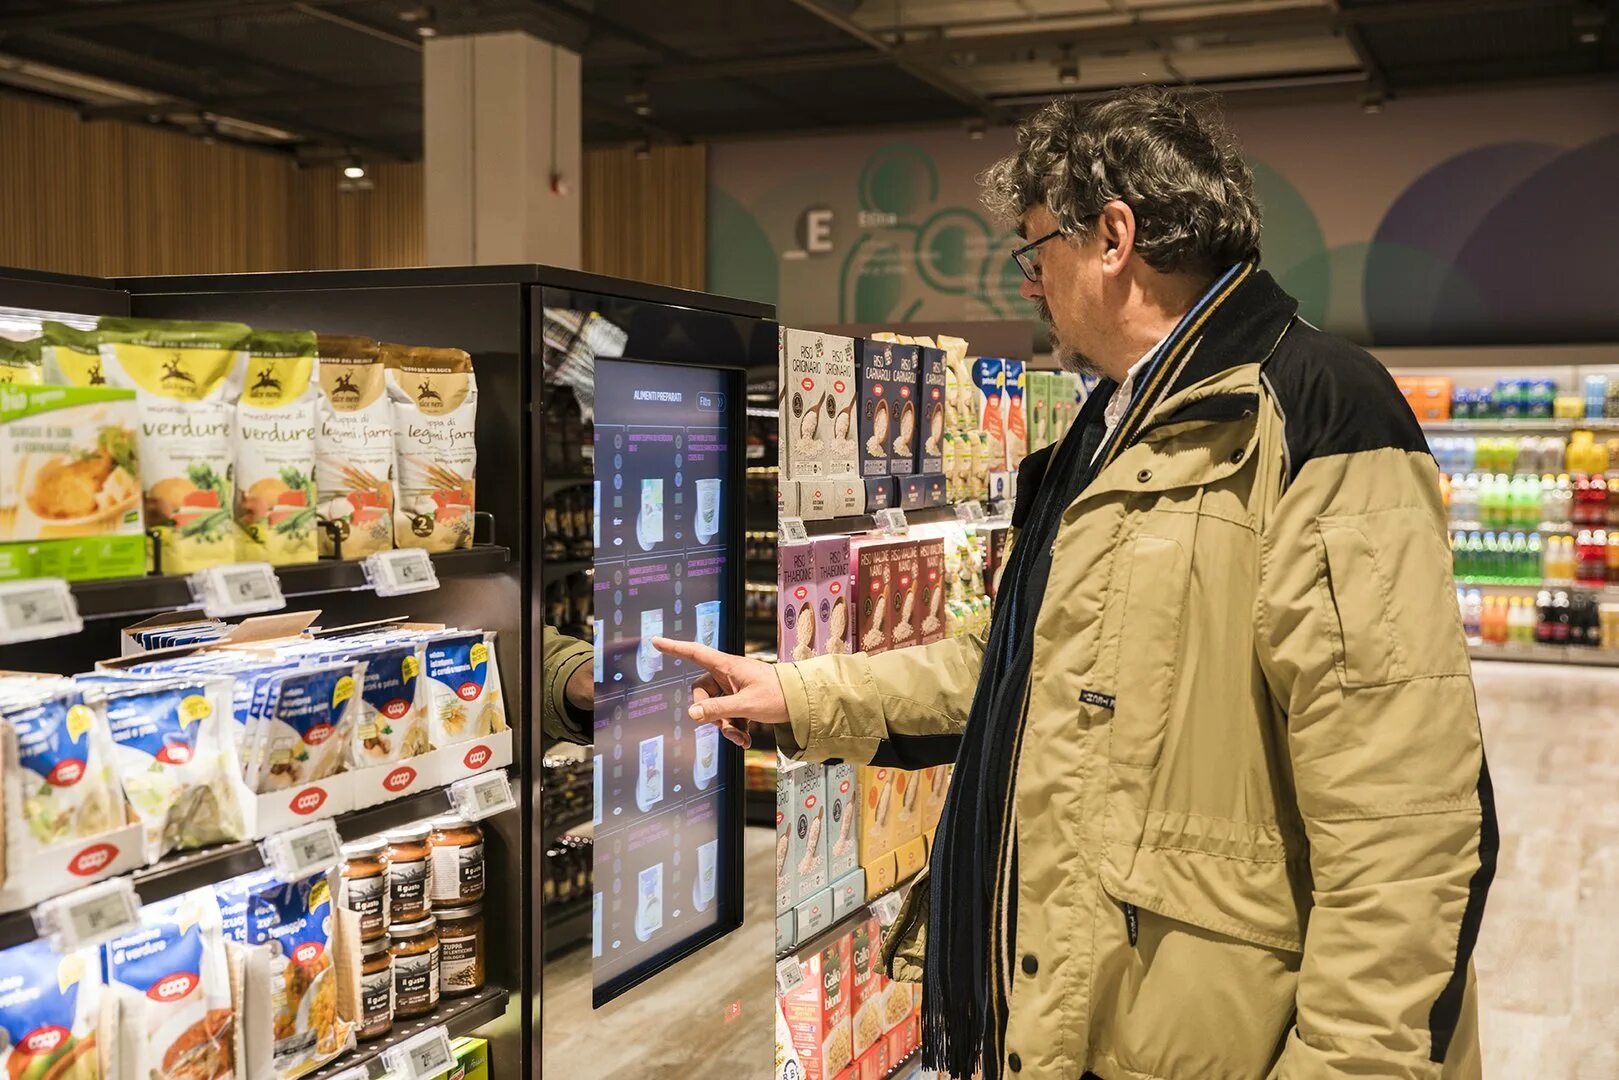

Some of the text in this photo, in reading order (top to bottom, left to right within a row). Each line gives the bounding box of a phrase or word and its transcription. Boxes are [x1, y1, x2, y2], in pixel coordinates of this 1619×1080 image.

[142, 417, 231, 437] verdure
[242, 422, 316, 442] verdure
[417, 517, 428, 530] 2
[443, 943, 463, 951] ZUPPA
[853, 946, 870, 966] Gallo
[824, 968, 841, 989] Gallo
